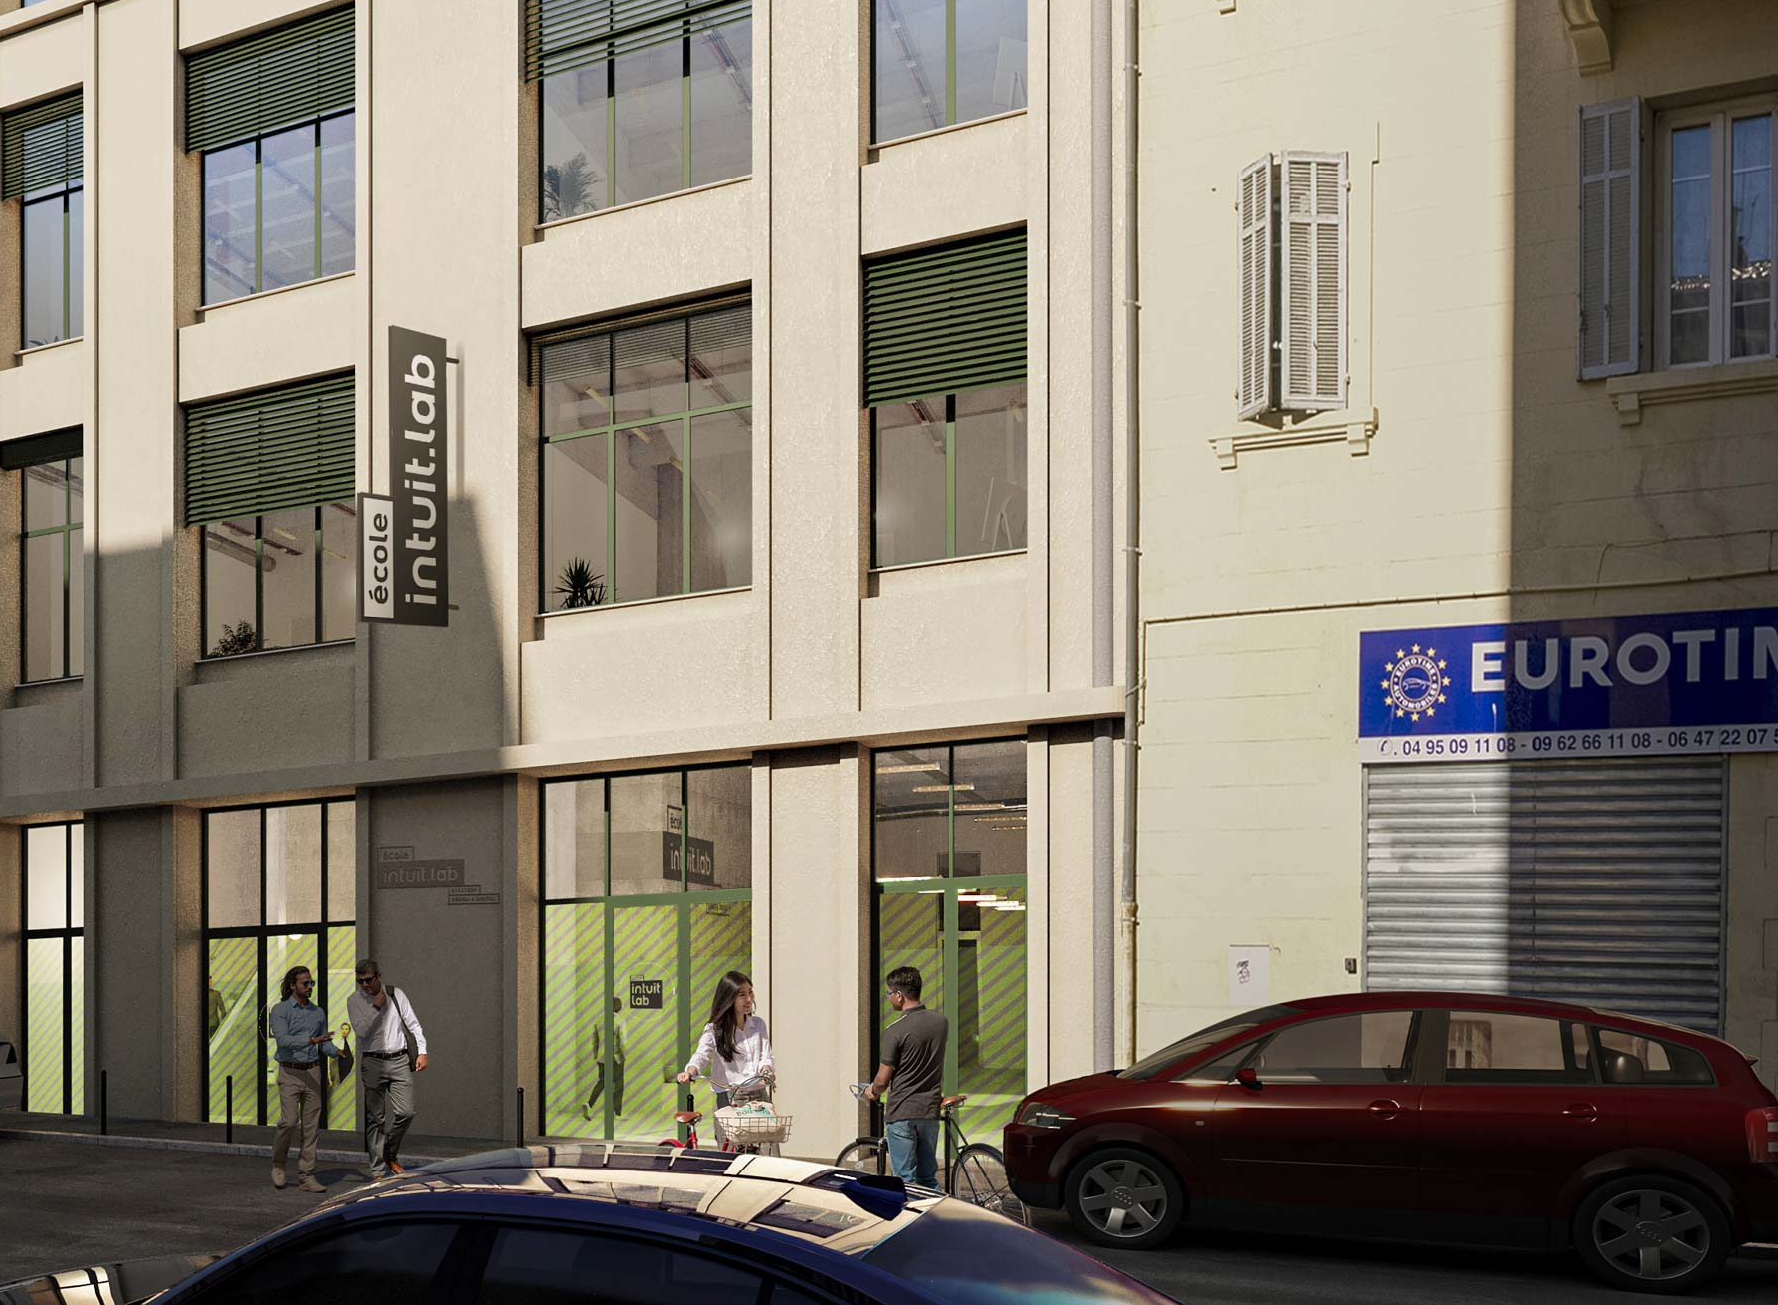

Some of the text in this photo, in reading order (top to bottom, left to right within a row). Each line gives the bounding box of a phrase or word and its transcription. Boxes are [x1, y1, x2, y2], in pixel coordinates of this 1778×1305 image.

[404, 353, 437, 606] intuit.lab
[369, 512, 389, 605] école
[1403, 740, 1421, 755] 04
[1426, 740, 1444, 755] 95
[1449, 739, 1468, 754] 09
[1475, 738, 1490, 753] 11
[1497, 737, 1516, 752] 08
[1533, 736, 1552, 752] 09
[1557, 735, 1576, 751] 62
[1582, 734, 1601, 750] 66
[1608, 733, 1623, 749] 11
[1631, 733, 1651, 748] 08
[1668, 731, 1688, 747] 06
[1694, 730, 1714, 746] 47
[1720, 729, 1741, 745] 22
[1747, 728, 1768, 744] 07
[384, 866, 459, 883] intuit.lab
[632, 982, 661, 994] intuit
[632, 995, 650, 1006] lab
